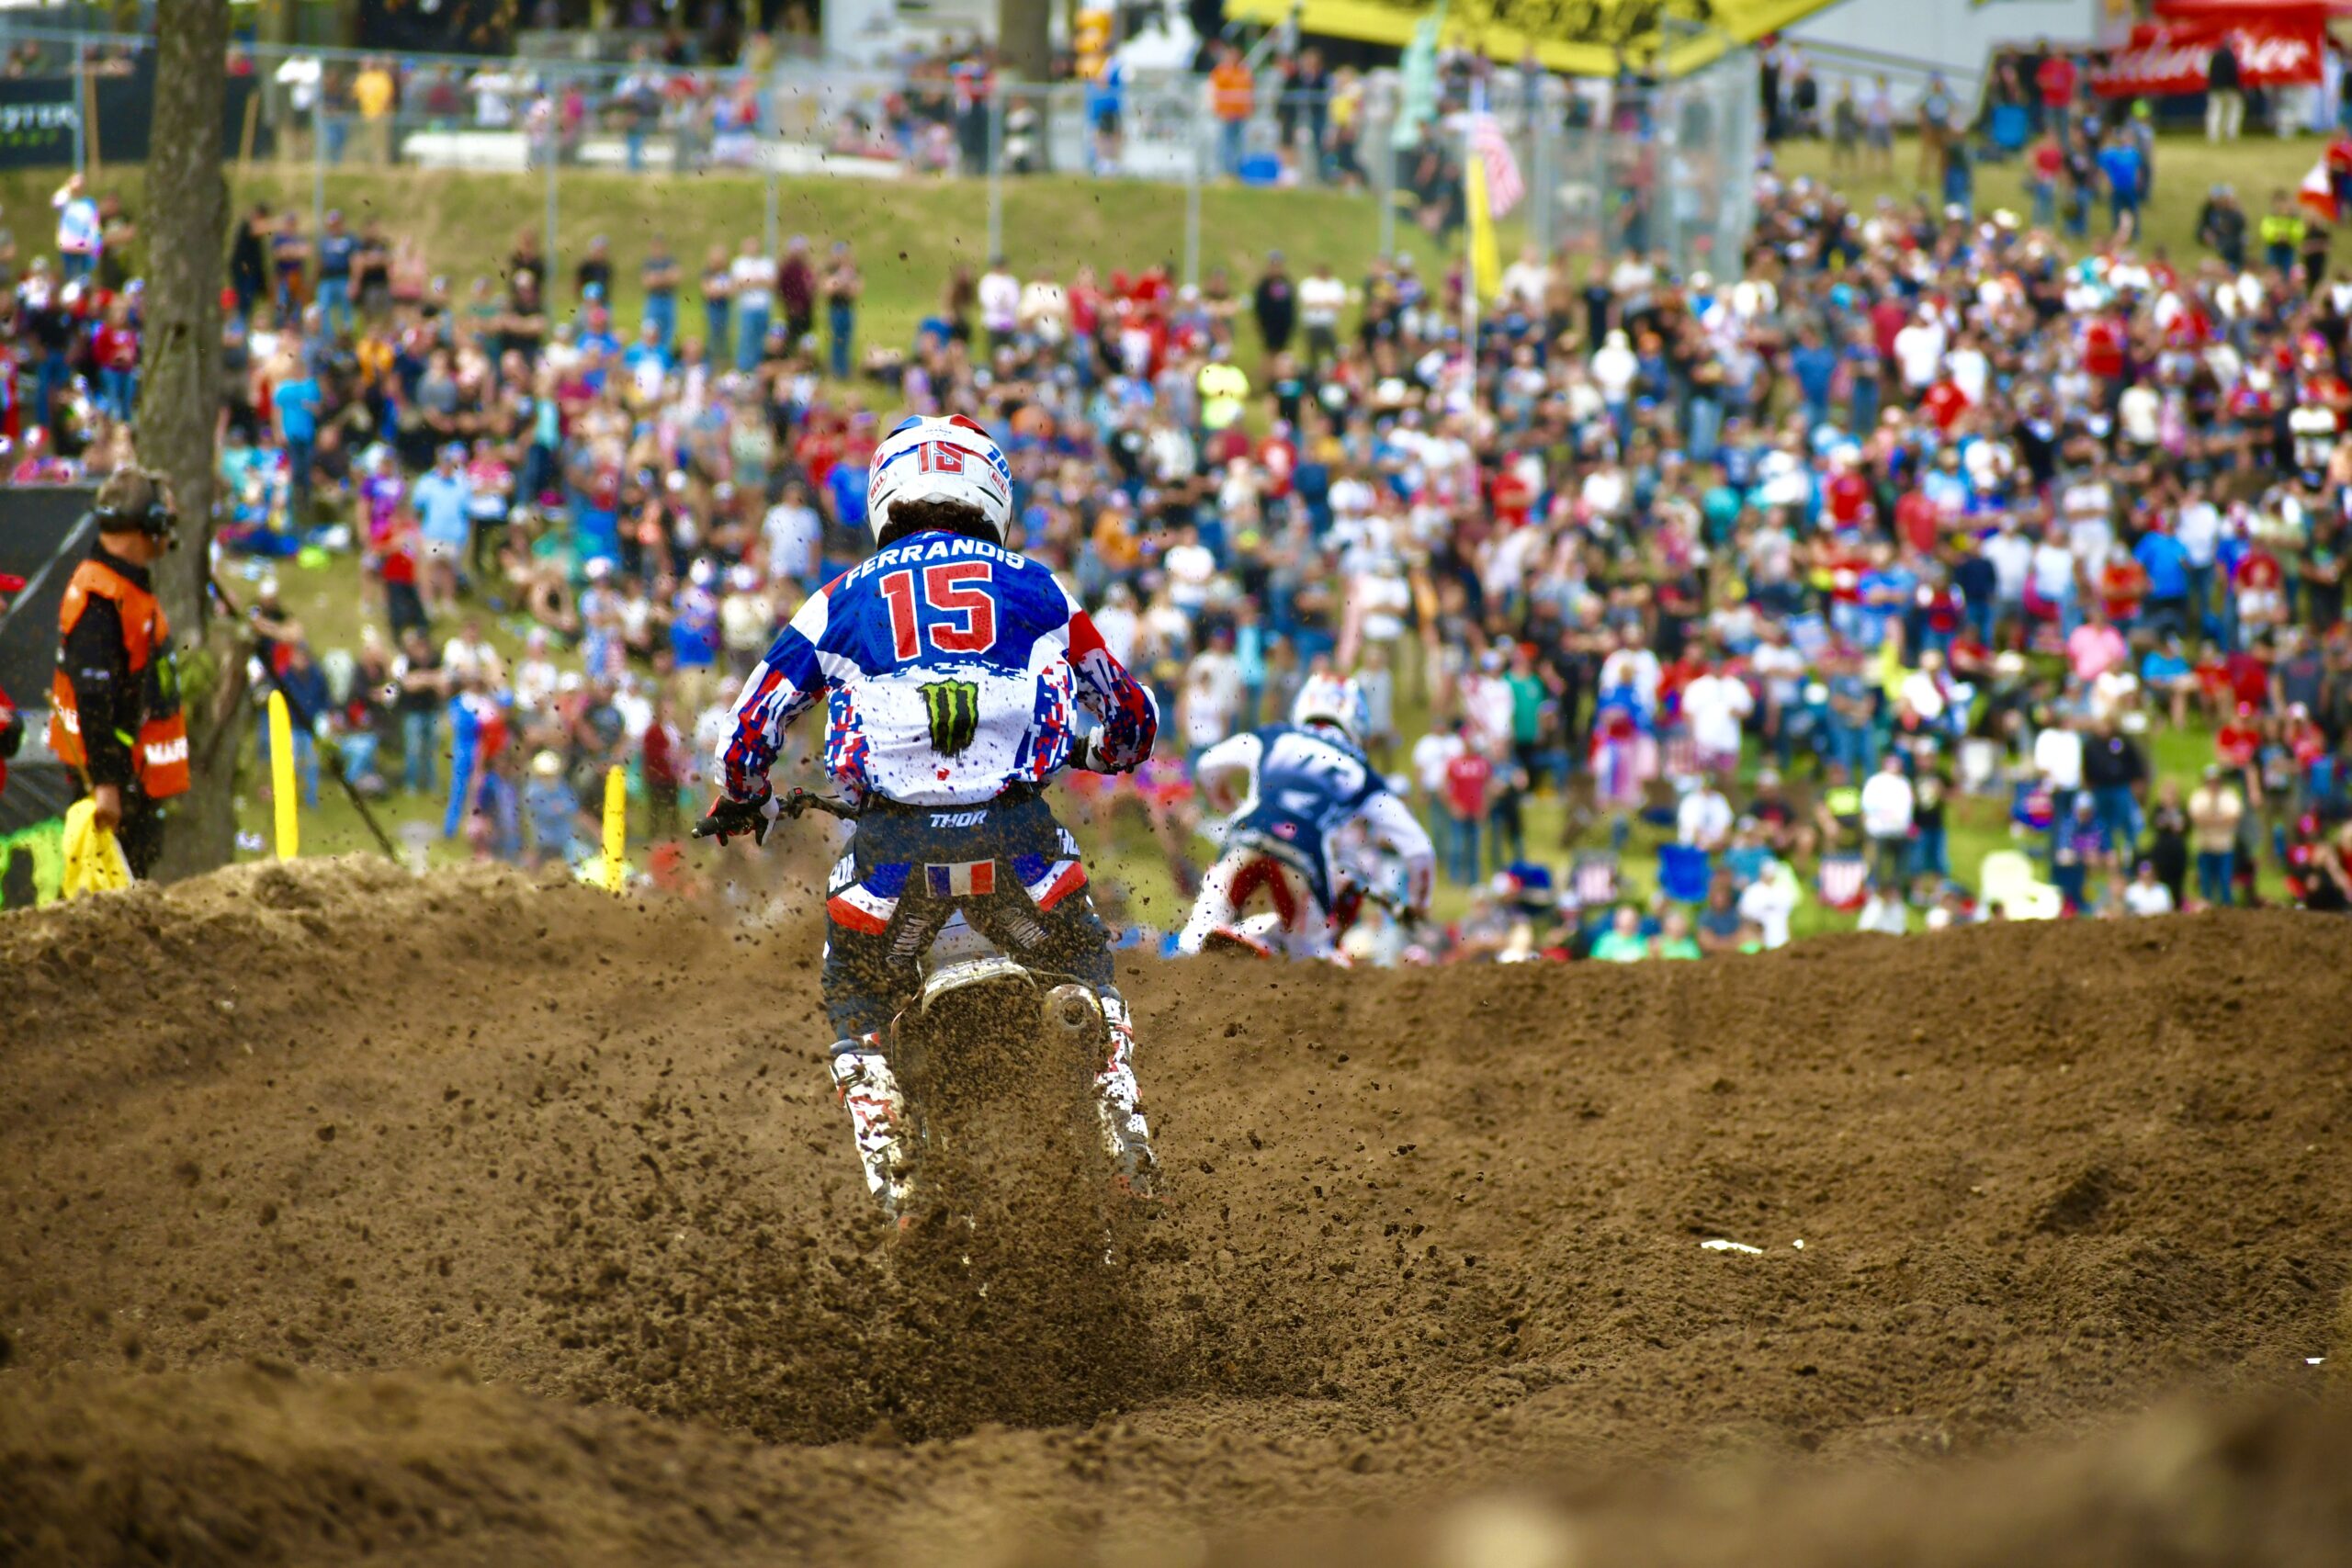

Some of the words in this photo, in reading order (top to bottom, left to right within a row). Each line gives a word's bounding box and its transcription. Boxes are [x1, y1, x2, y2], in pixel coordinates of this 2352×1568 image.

[918, 440, 964, 475] 15
[869, 476, 885, 499] BELL
[991, 470, 1007, 497] BELL
[844, 538, 1025, 590] FERRANDIS
[878, 559, 997, 662] 15
[930, 808, 989, 828] THOR
